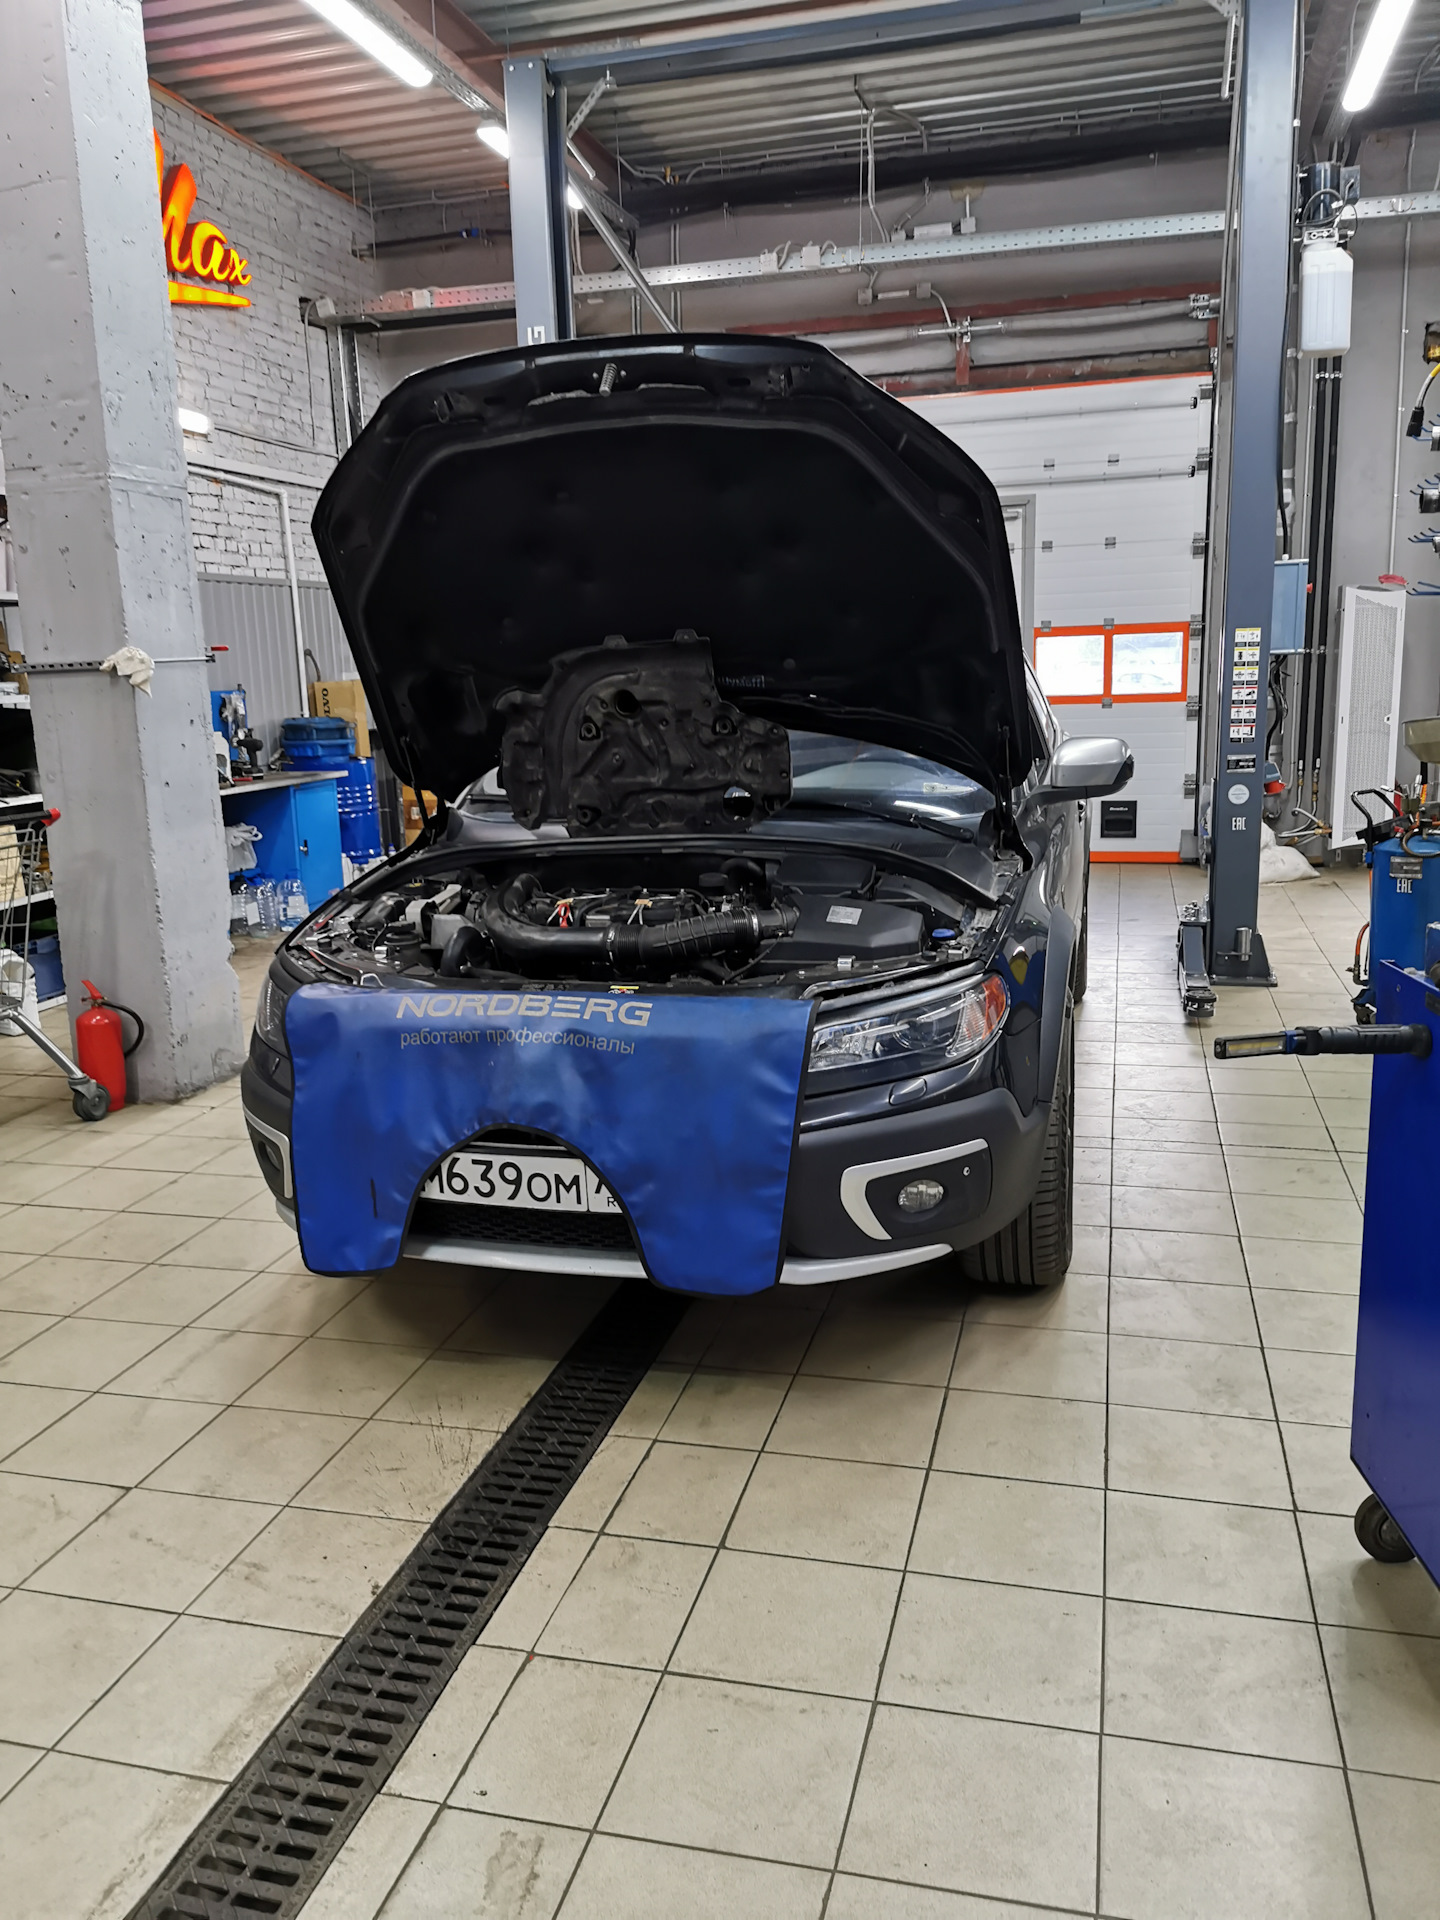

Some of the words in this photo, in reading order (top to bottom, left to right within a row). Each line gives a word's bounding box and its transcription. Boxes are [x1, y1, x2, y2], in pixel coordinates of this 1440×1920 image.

[321, 687, 331, 717] LVO
[1231, 816, 1247, 831] EAC
[1396, 878, 1413, 894] EAC
[396, 993, 654, 1027] NORDBERG
[400, 1027, 481, 1050] работают
[486, 1026, 636, 1055] профессионалы
